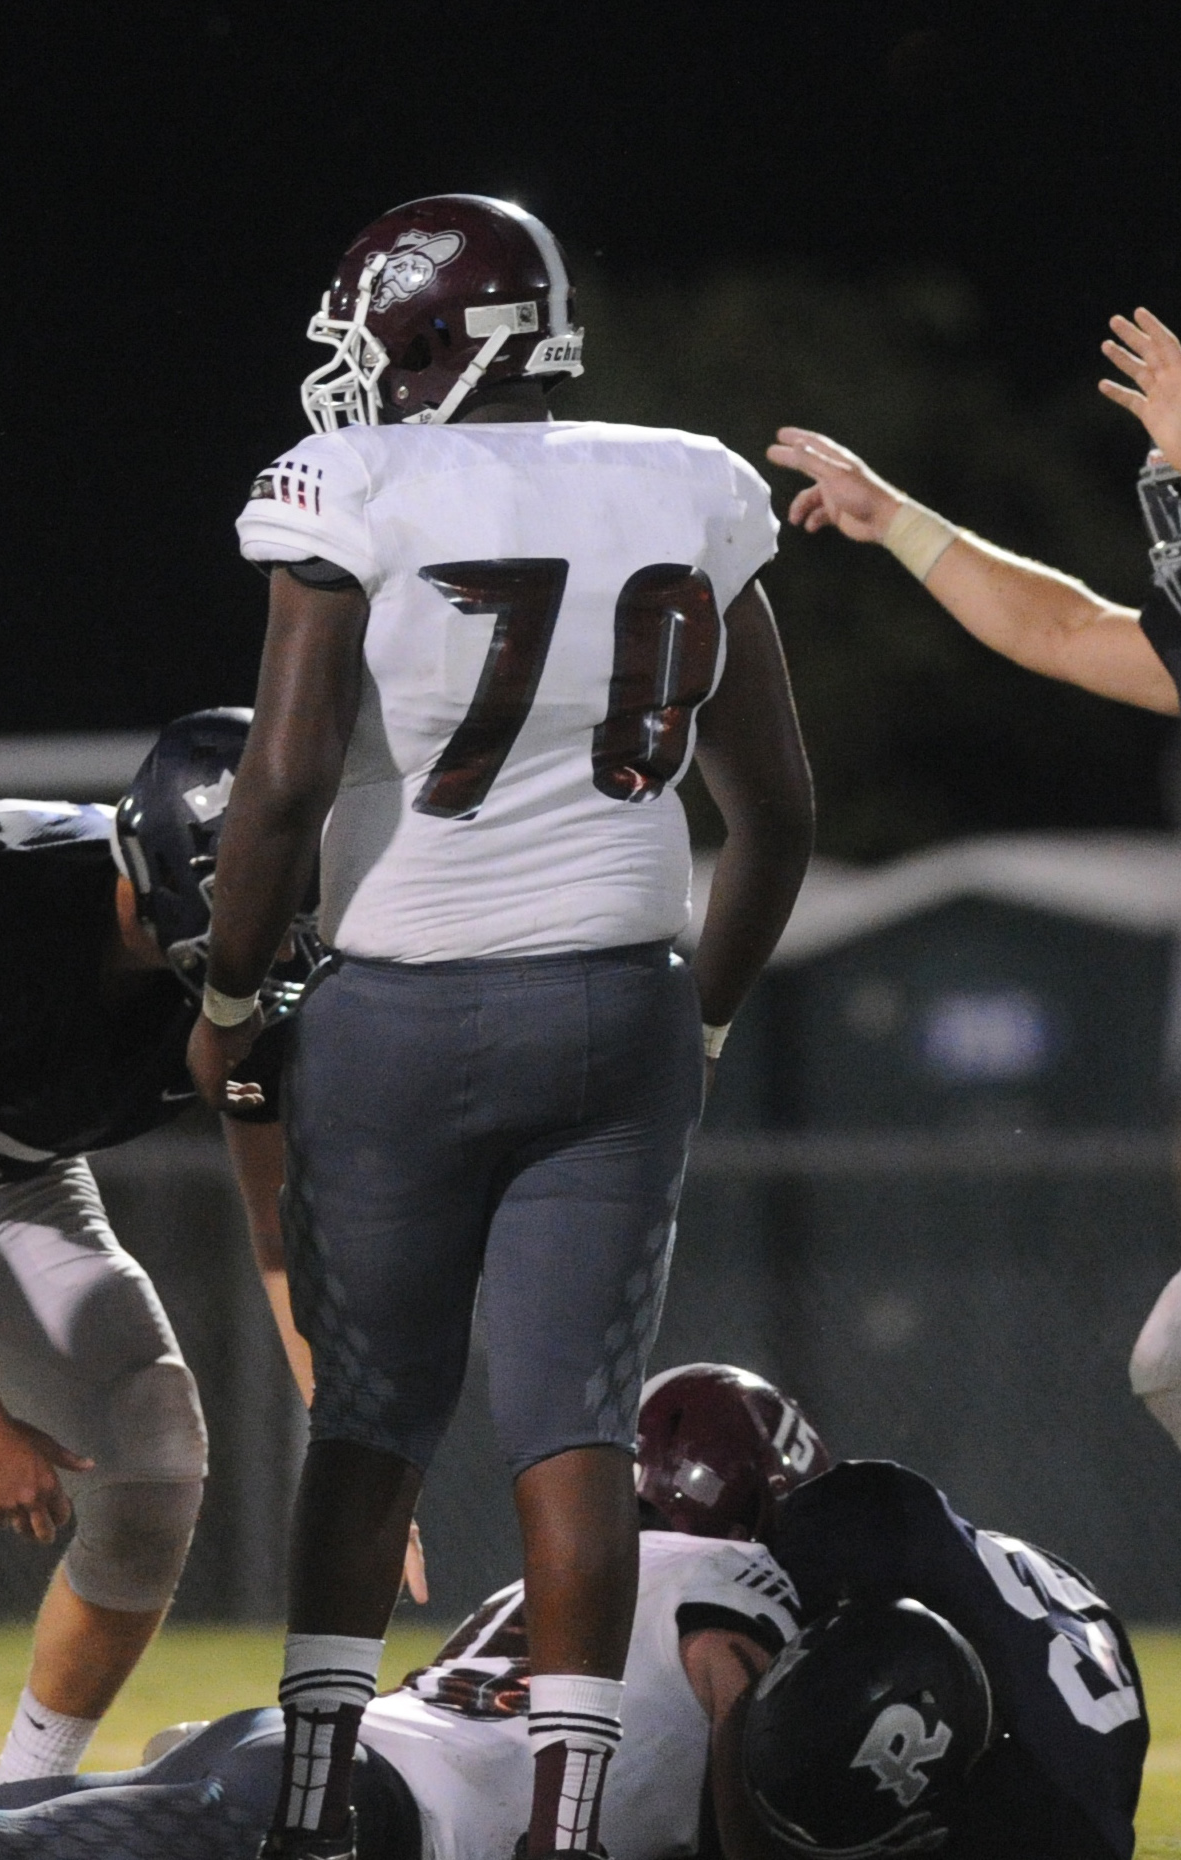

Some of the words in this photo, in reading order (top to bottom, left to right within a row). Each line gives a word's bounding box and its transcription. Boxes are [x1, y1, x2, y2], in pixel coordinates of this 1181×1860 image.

[411, 556, 723, 821] 70
[772, 1399, 819, 1475] 15
[850, 1702, 953, 1808] R
